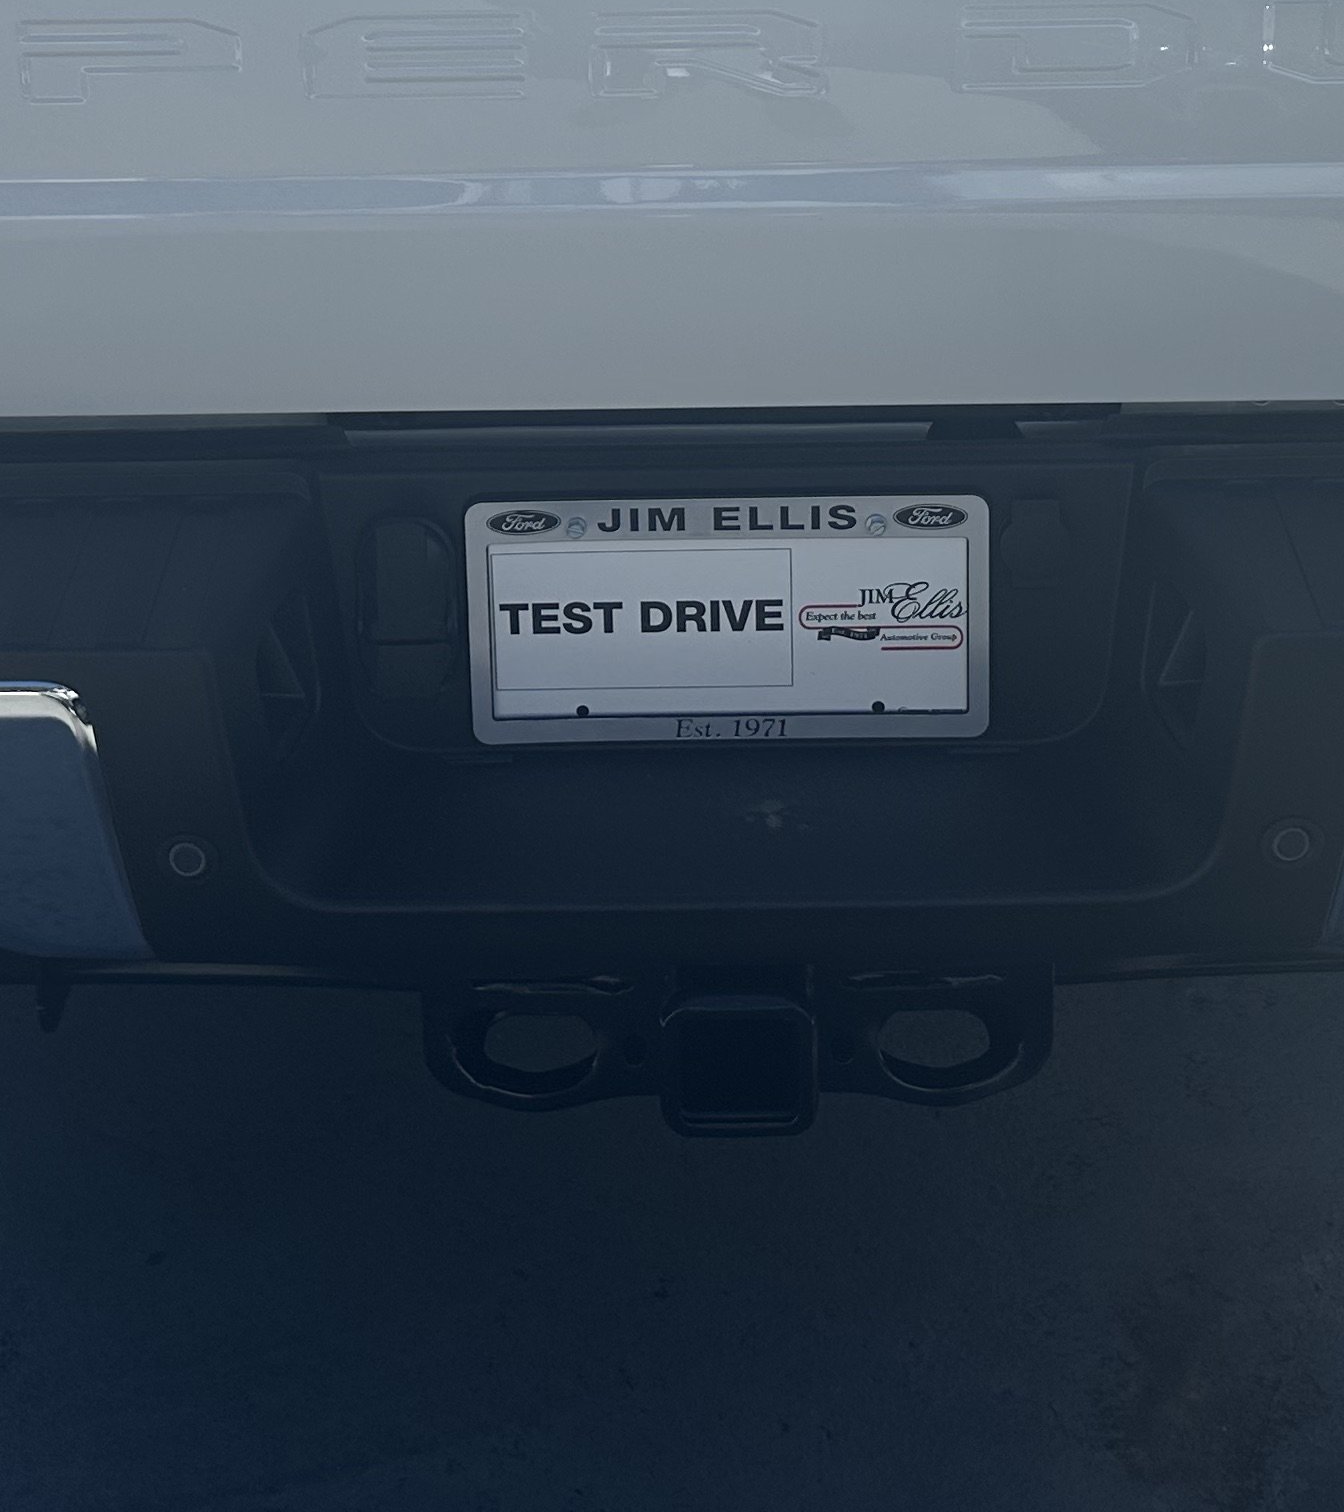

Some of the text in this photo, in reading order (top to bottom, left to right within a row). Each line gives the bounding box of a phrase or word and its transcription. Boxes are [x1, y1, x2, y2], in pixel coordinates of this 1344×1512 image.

[501, 514, 546, 532] Ford
[596, 504, 858, 533] JIM ELLIS
[907, 507, 953, 526] Ford
[858, 581, 968, 623] JIM Ellis
[499, 599, 785, 635] TEST DRIVE
[806, 609, 877, 623] Expect the best
[880, 633, 928, 641] Automotive
[676, 717, 789, 739] Est. 1971
